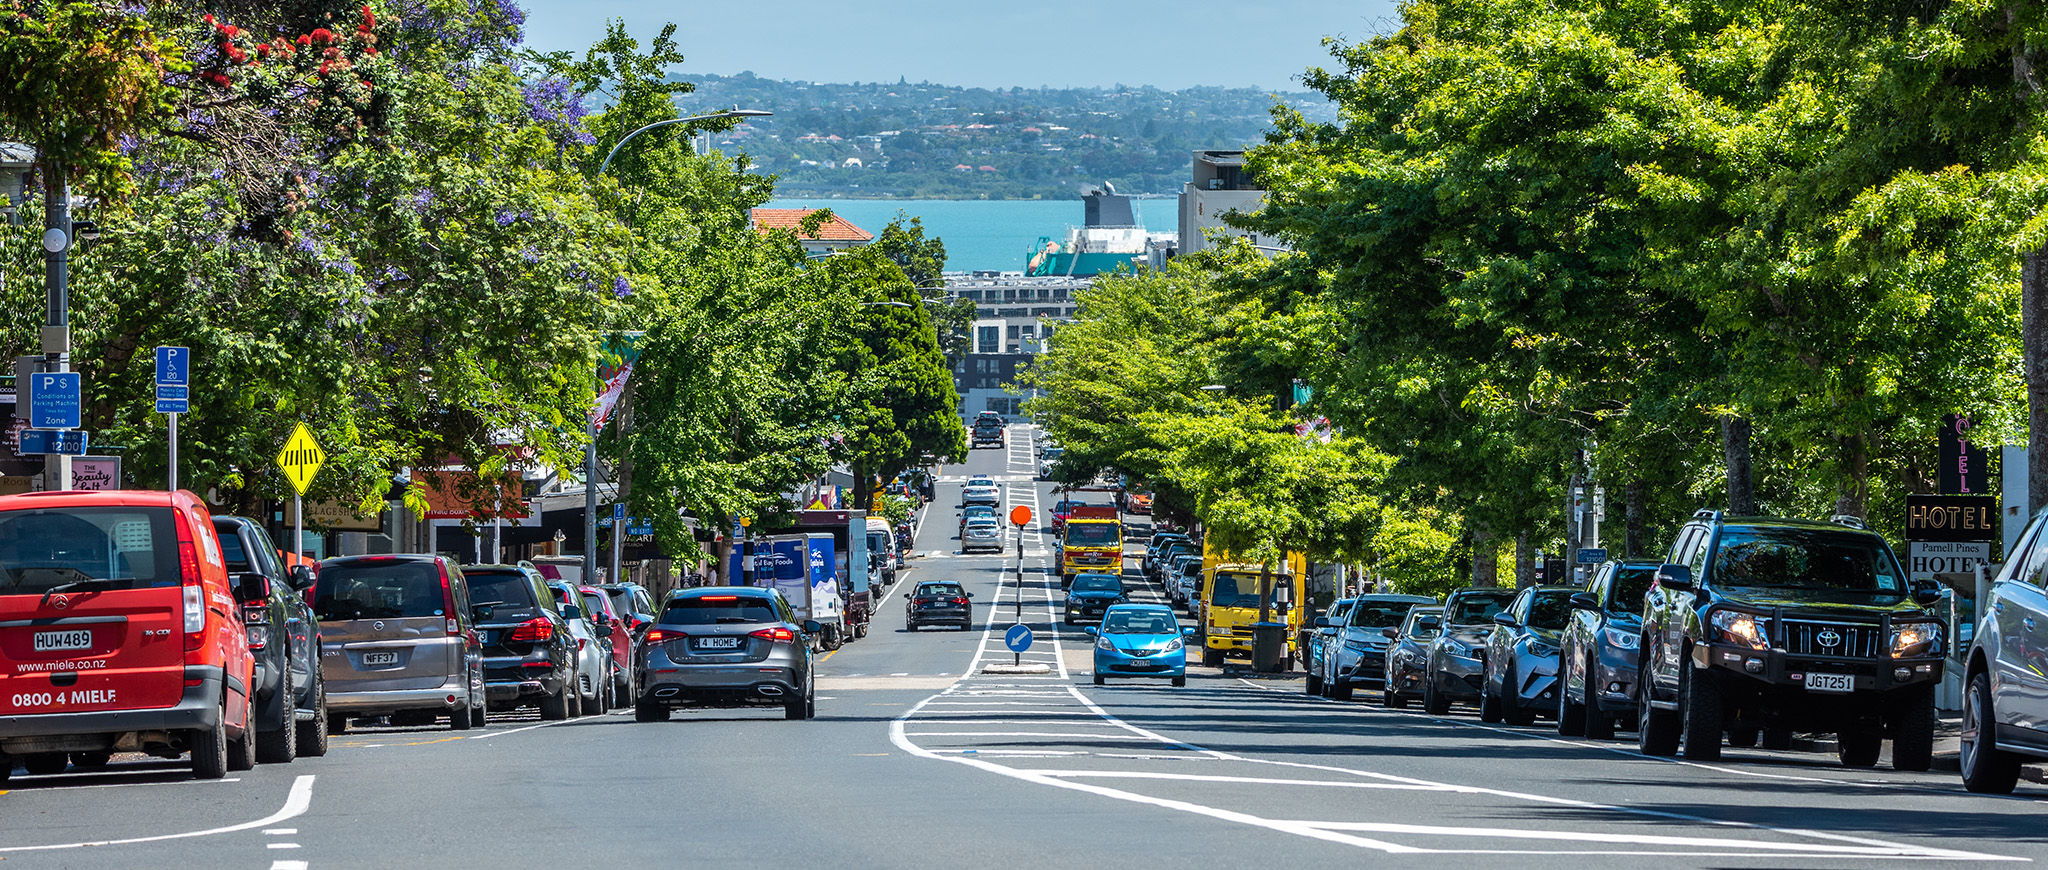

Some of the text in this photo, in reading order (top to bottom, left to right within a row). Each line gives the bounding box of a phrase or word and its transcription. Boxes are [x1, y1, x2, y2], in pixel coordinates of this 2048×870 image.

[168, 349, 178, 361] P
[167, 372, 178, 380] 120
[44, 377, 54, 390] P
[45, 417, 66, 425] Zone
[1954, 418, 1970, 493] OTEL
[72, 470, 112, 486] Beauty
[1909, 506, 1991, 530] HOTEL
[1922, 543, 1980, 554] Parnell Pines
[36, 631, 90, 649] HUW489
[702, 639, 735, 648] 4 HOME
[366, 652, 395, 664] NFF37
[17, 660, 107, 672] www.miele.co.nz
[1807, 676, 1851, 690] JGT251
[12, 690, 116, 707] 0800 4 MIELE
